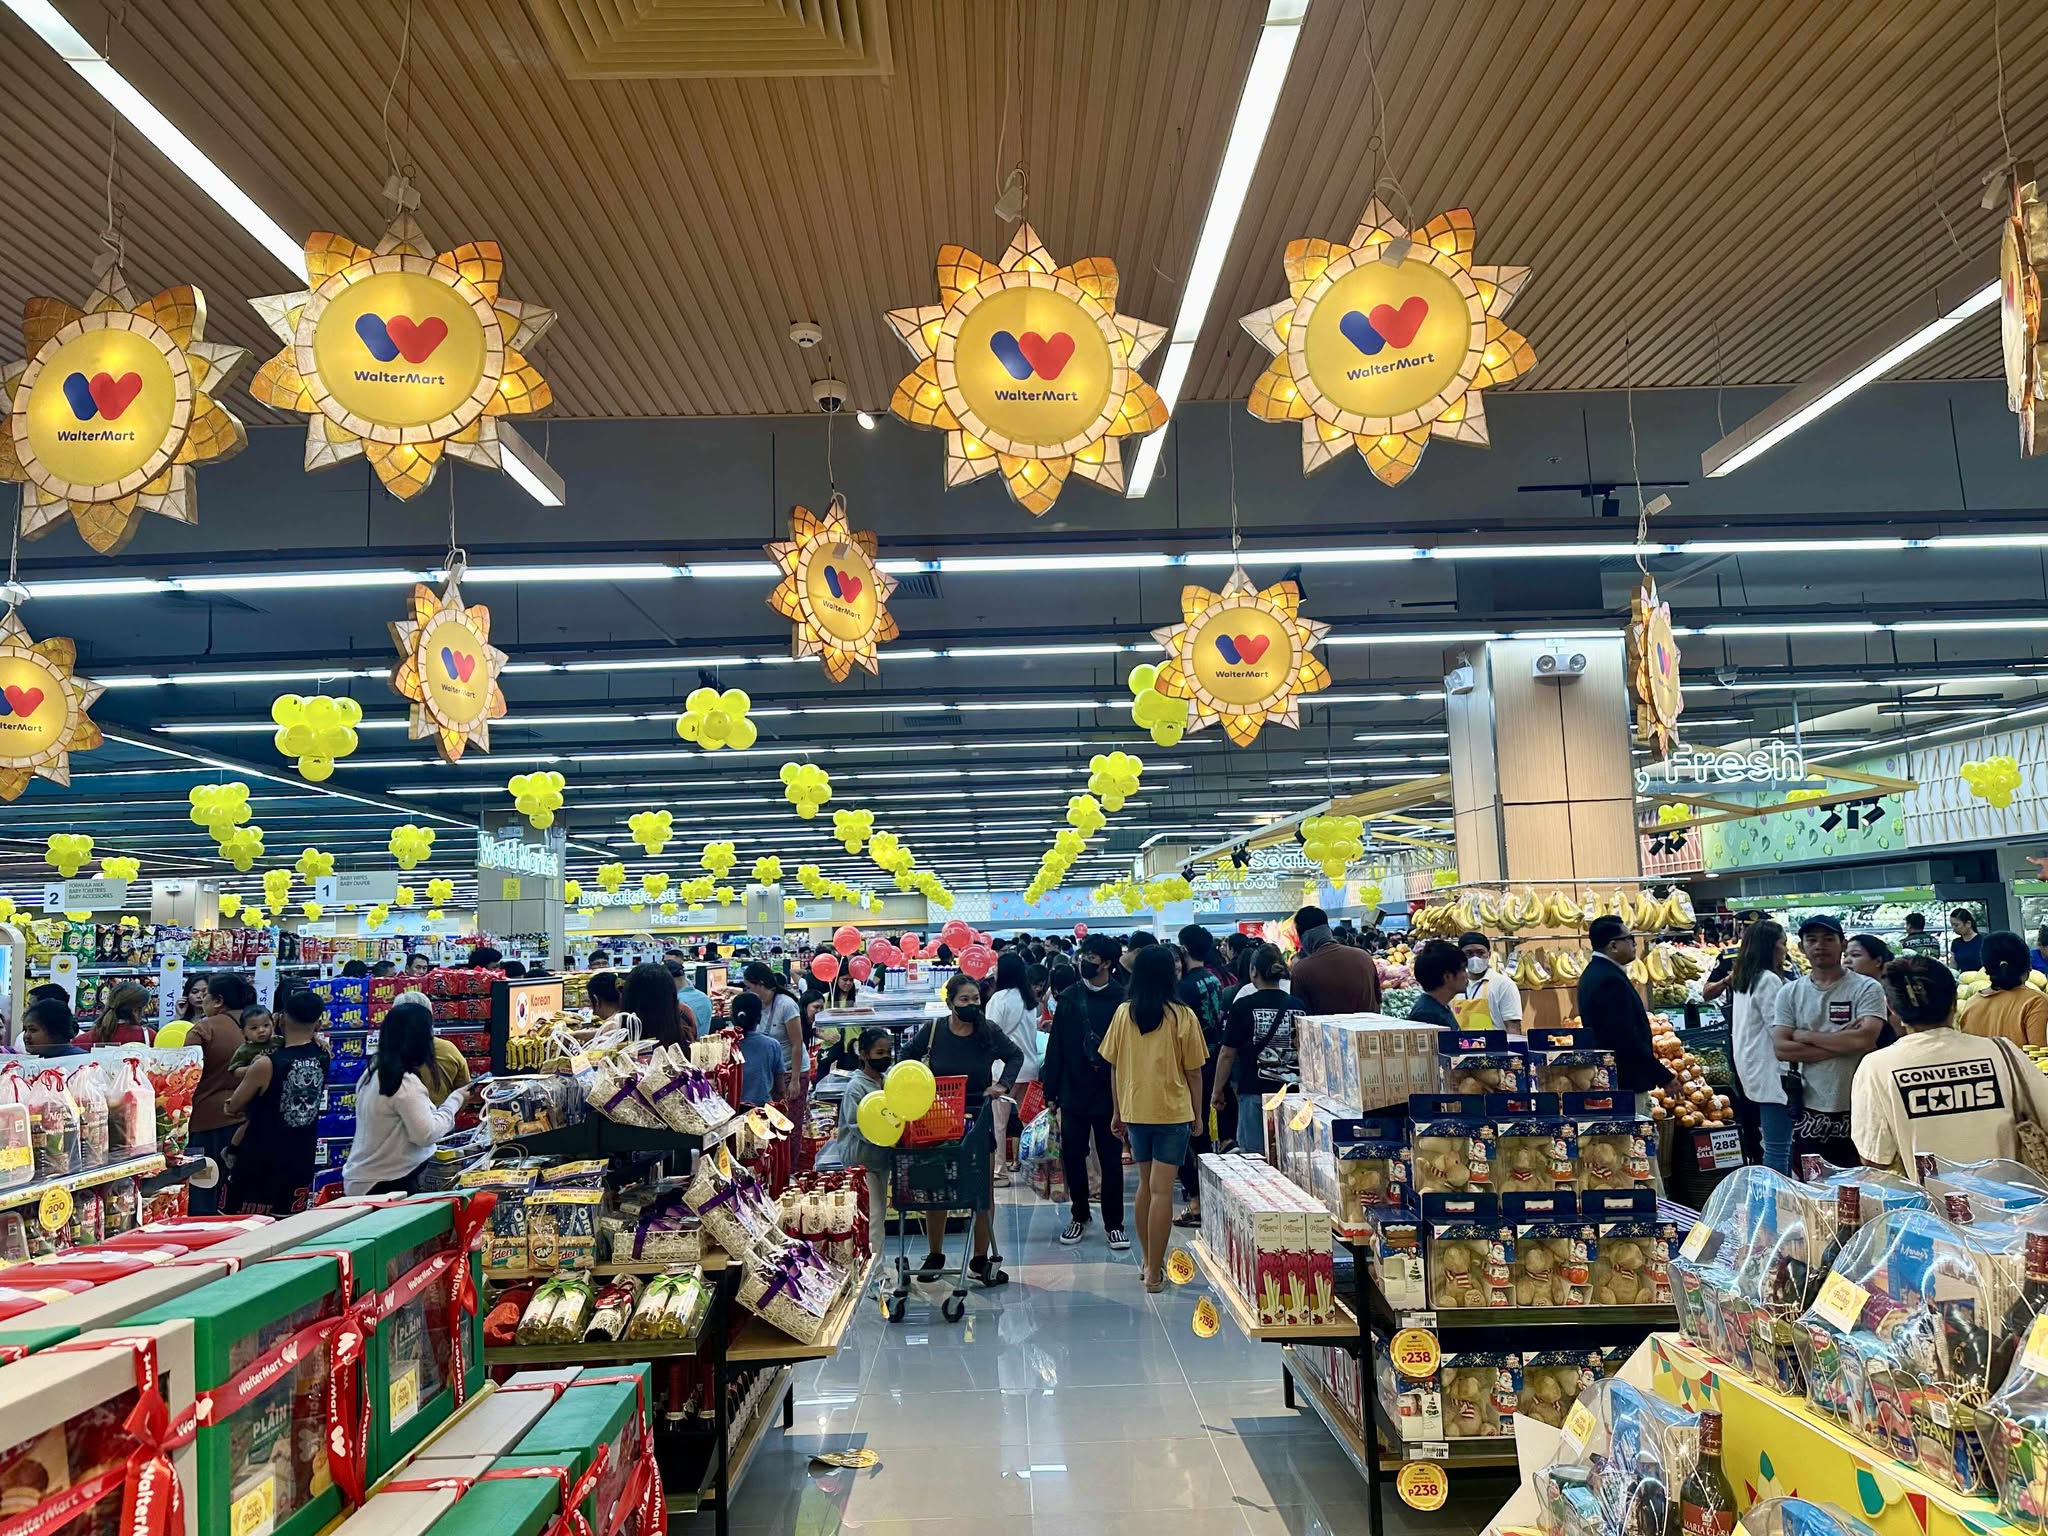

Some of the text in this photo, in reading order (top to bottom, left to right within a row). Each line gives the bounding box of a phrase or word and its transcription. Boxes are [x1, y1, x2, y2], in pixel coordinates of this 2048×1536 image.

[1346, 353, 1435, 380] WalterMart
[354, 370, 445, 385] WalterMart
[994, 390, 1078, 401] WalterMart
[57, 430, 135, 441] WalterMart
[822, 599, 861, 620] WalterMart
[1664, 740, 1805, 785] Fresh
[479, 834, 518, 868] World
[1249, 850, 1322, 869] Seafo
[323, 884, 330, 897] 1
[1233, 874, 1278, 890] Food
[49, 892, 59, 905] 2
[650, 914, 678, 925] Rice
[166, 989, 175, 1017] U.S.A.
[530, 994, 551, 1007] Korean
[291, 1059, 321, 1070] TRIBAL
[1899, 1063, 1991, 1084] CONVERSE
[513, 1208, 528, 1237] ORE
[578, 1208, 593, 1236] ORE
[534, 1246, 553, 1257] TANG
[407, 1265, 435, 1291] WalterMart
[238, 1358, 284, 1396] WalterMart
[252, 1404, 288, 1439] PLAIN
[1913, 1413, 1953, 1447] SPAM
